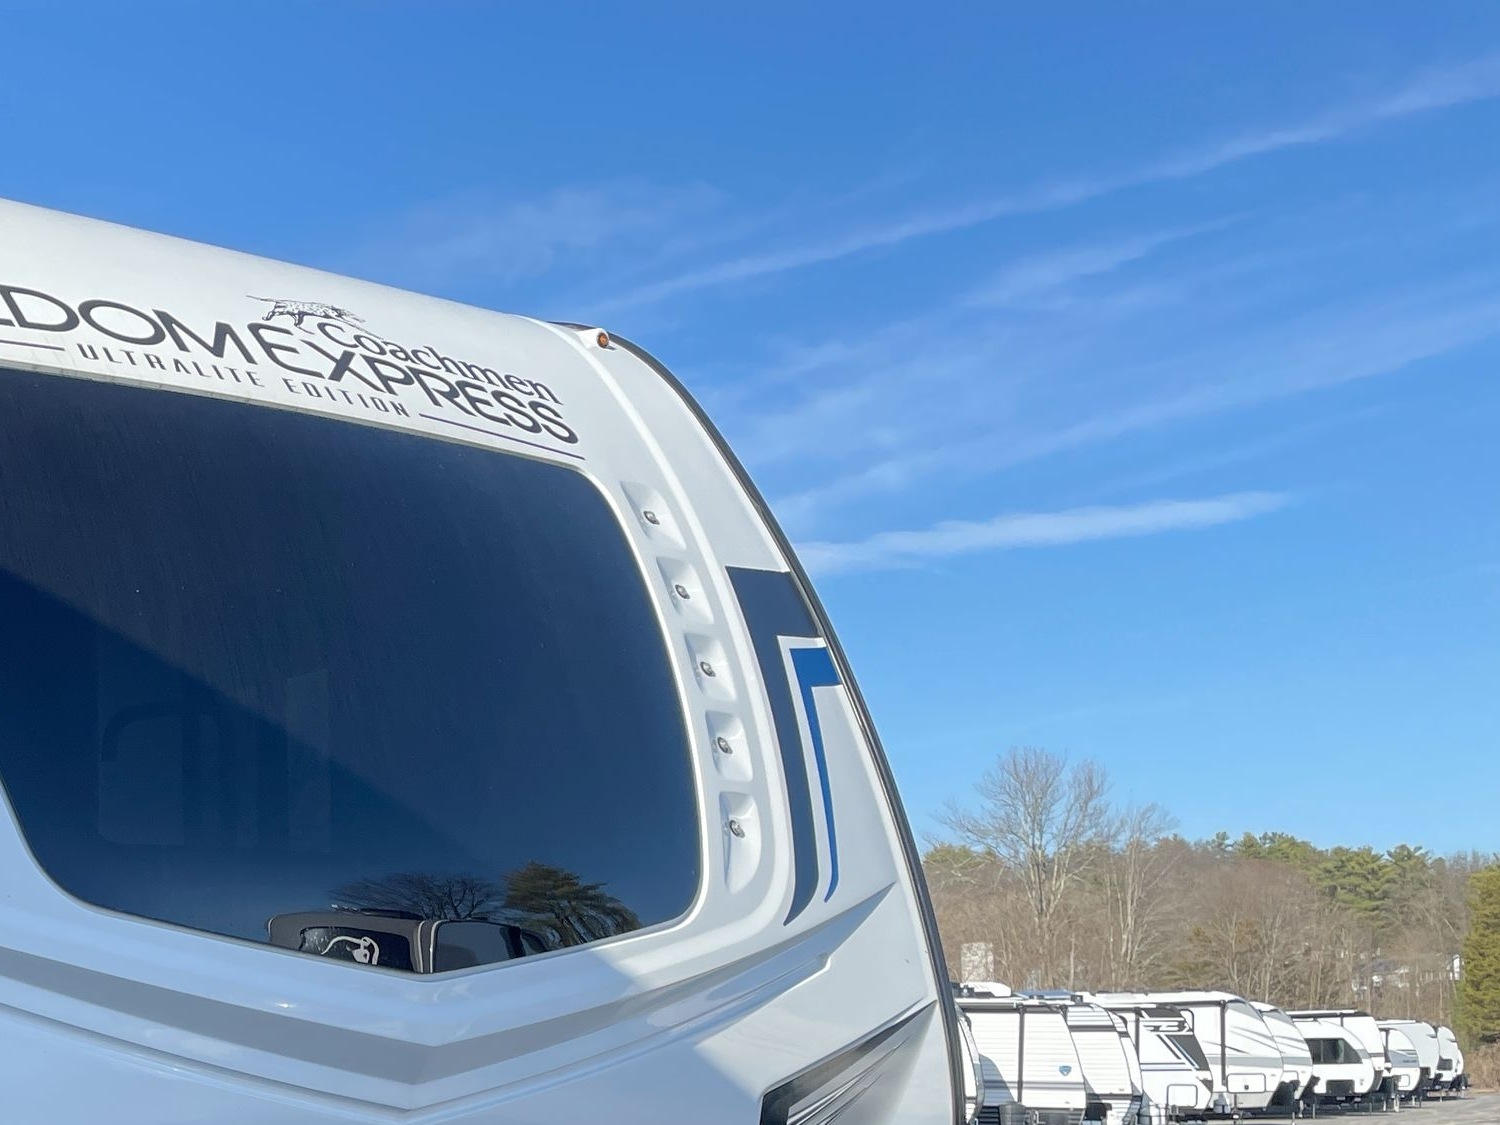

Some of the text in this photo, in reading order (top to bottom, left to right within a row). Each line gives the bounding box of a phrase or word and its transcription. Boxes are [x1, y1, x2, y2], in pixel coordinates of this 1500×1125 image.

[77, 343, 411, 418] ULTRALITE EDITION
[246, 321, 580, 445] EXPRESS
[318, 321, 565, 406] Coachmen
